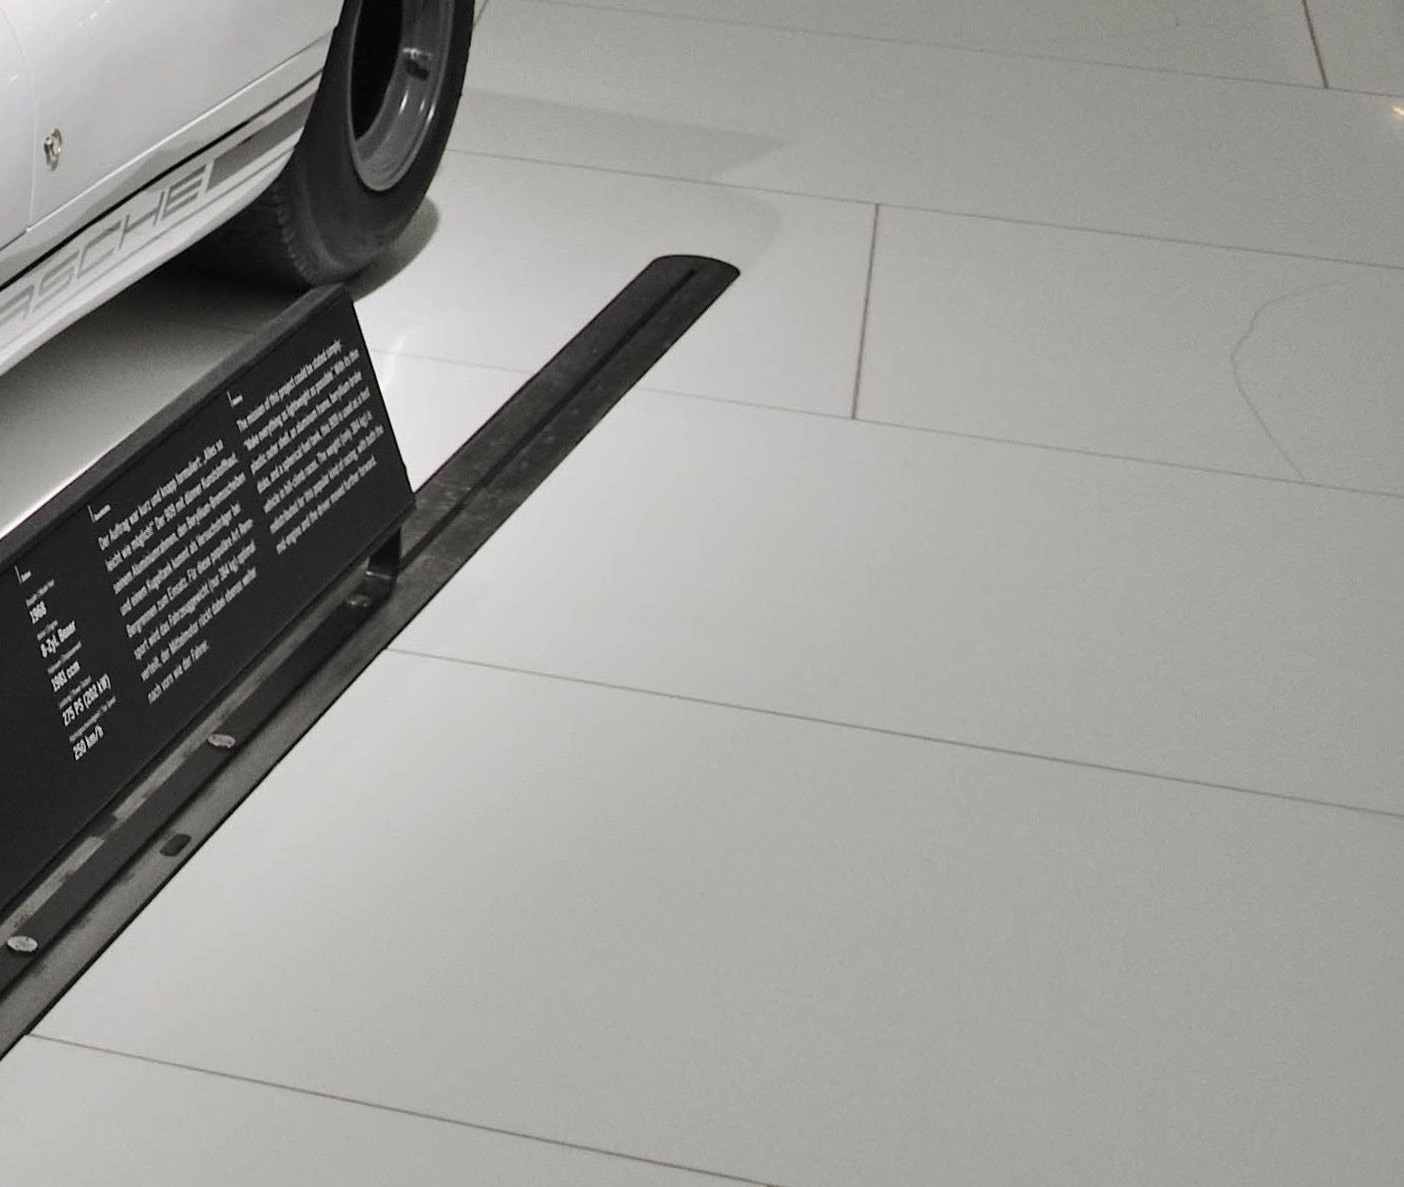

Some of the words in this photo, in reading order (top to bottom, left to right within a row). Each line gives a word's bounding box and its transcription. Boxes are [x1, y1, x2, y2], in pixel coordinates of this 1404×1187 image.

[30, 601, 46, 624] 1968
[40, 634, 60, 658] 8-Zyl.
[57, 621, 76, 642] Boxer
[66, 661, 80, 679] ccm
[62, 706, 75, 726] 275
[74, 697, 84, 715] PS
[97, 674, 111, 693] kW)
[73, 739, 86, 760] 250
[85, 725, 103, 749] km/h
